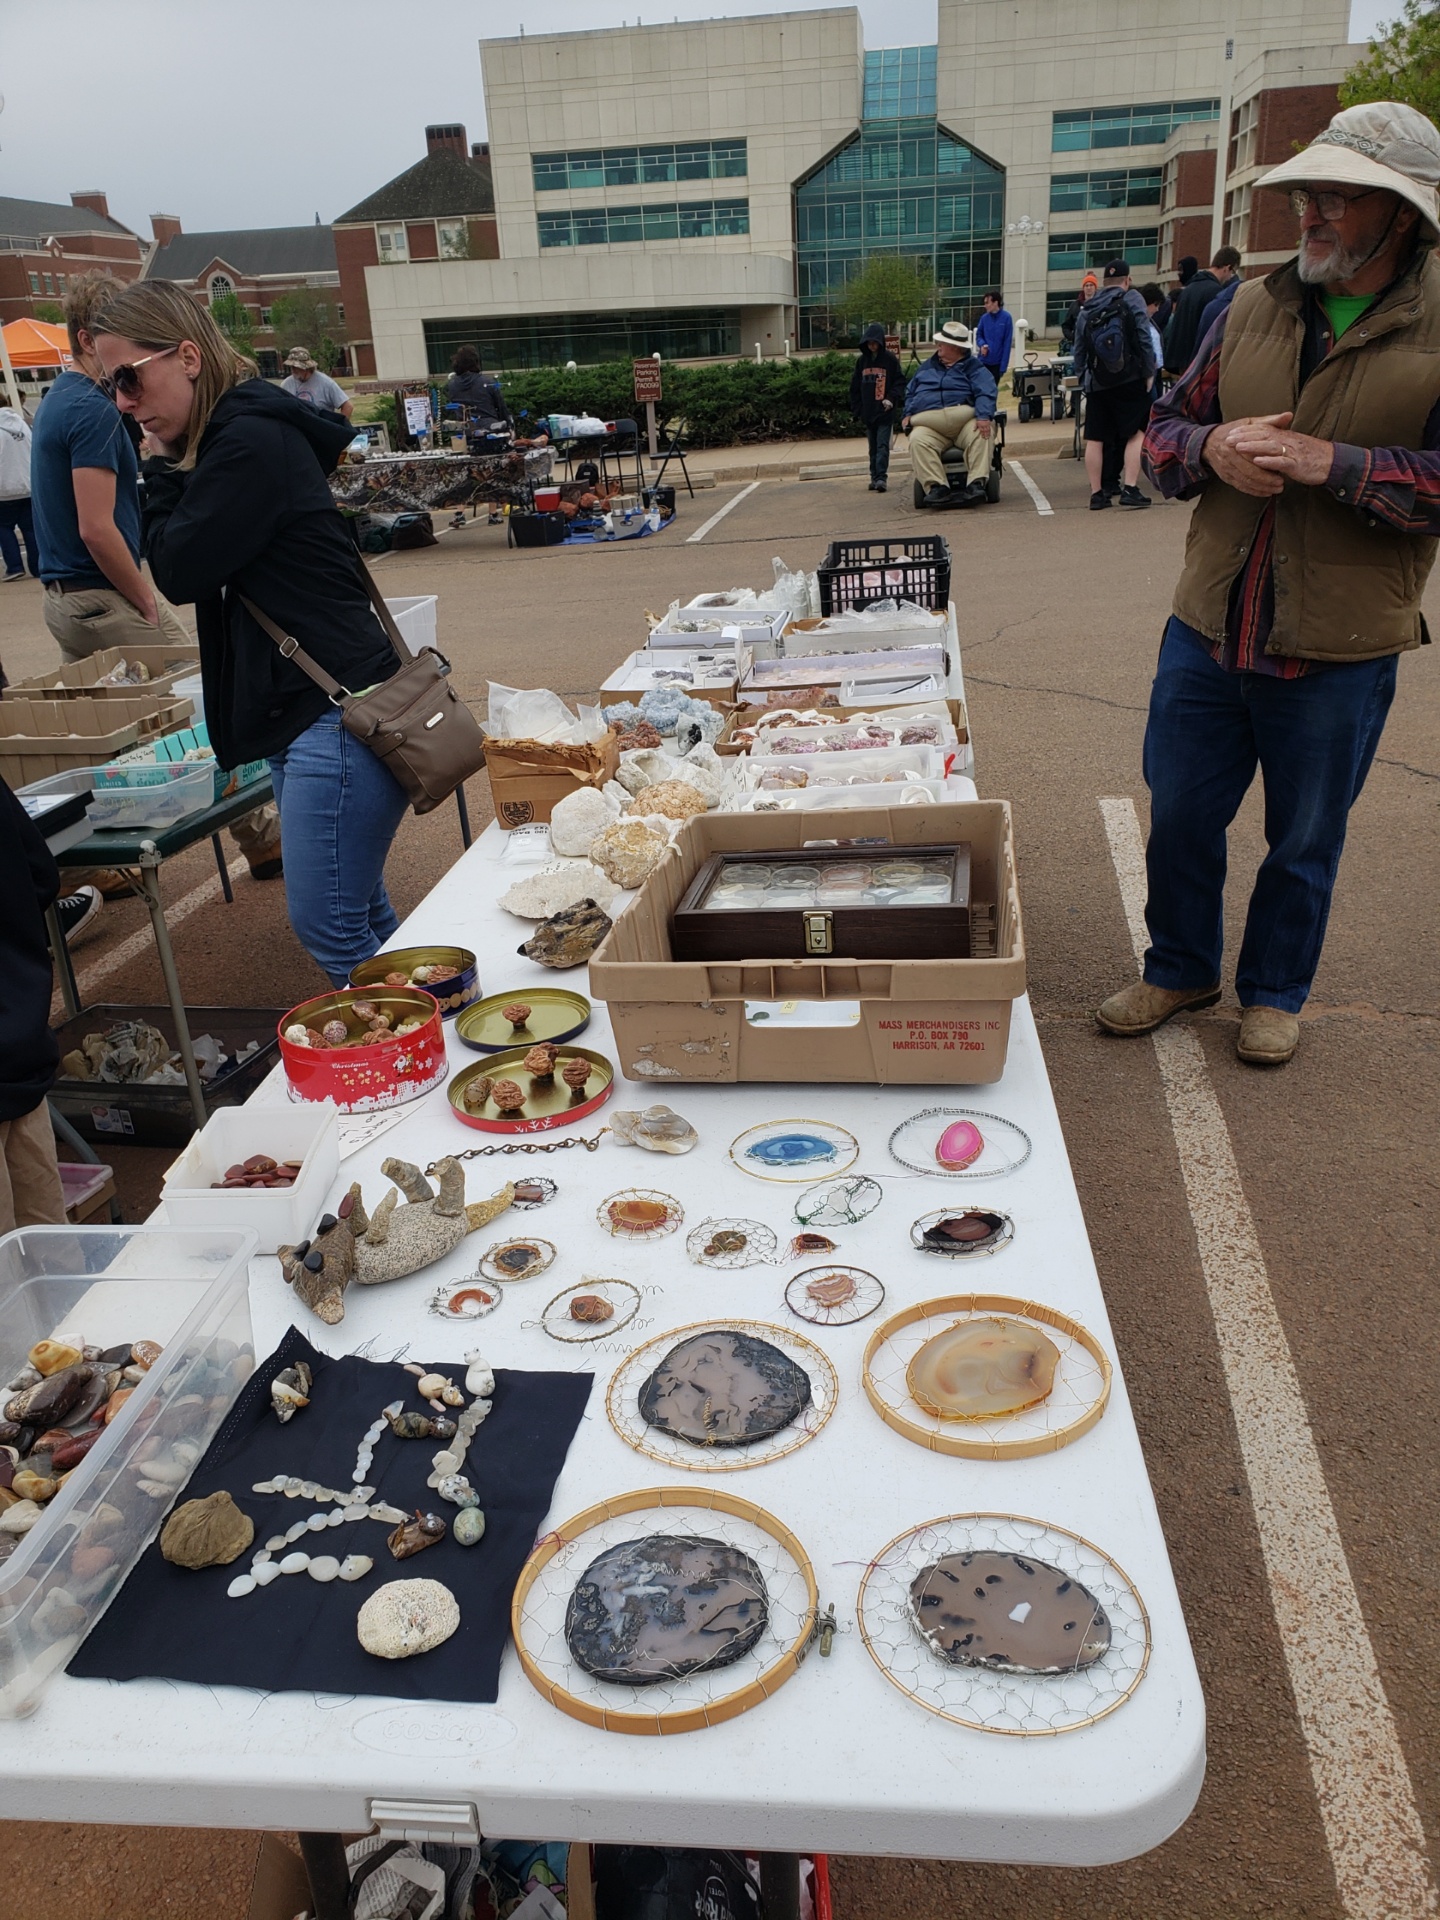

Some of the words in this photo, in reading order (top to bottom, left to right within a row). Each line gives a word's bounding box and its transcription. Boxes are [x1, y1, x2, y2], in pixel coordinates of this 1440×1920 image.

[879, 1021, 902, 1030] MASS
[907, 1021, 980, 1030] MERCHANDISERS
[985, 1021, 1000, 1030] INC
[910, 1031, 927, 1039] P.O.
[931, 1031, 948, 1040] BOX
[953, 1031, 969, 1040] 790
[893, 1041, 940, 1051] HARRISON,
[943, 1042, 955, 1050] AR
[960, 1042, 985, 1051] 72601
[331, 1061, 369, 1069] Christmas
[383, 1720, 486, 1742] COSCO
